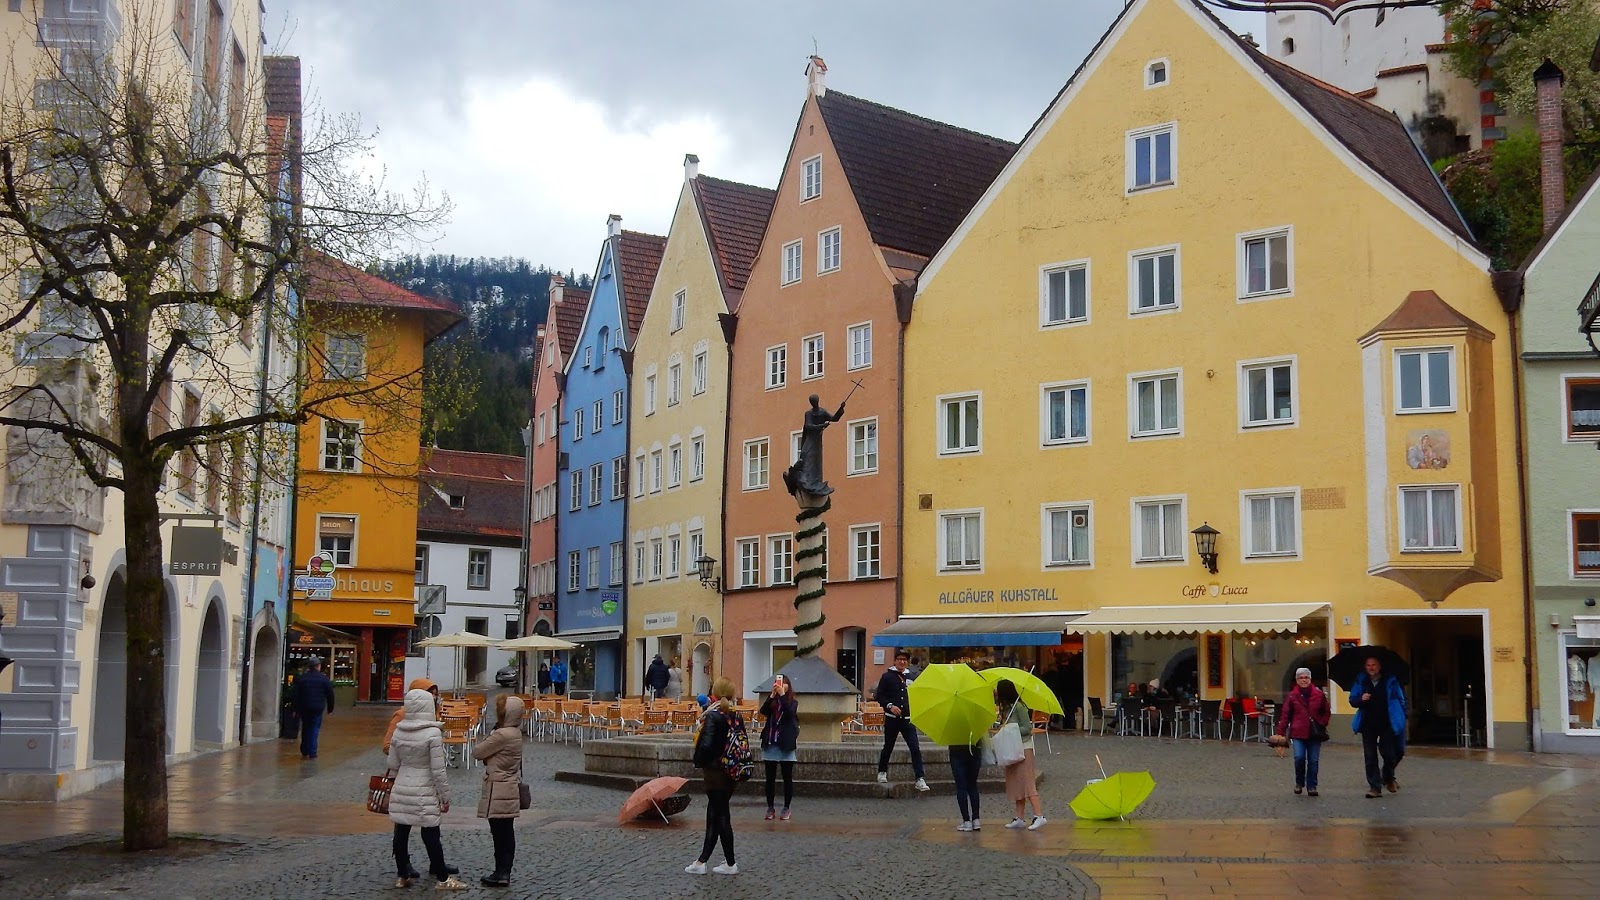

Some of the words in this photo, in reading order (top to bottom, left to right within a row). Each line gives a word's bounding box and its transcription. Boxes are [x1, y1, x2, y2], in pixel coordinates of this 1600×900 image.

[173, 562, 218, 570] ESPRIT
[336, 573, 393, 592] hhaus
[938, 588, 995, 604] ALLGÄUER
[1000, 588, 1059, 602] KUHSTALL
[1221, 585, 1249, 596] Lucca
